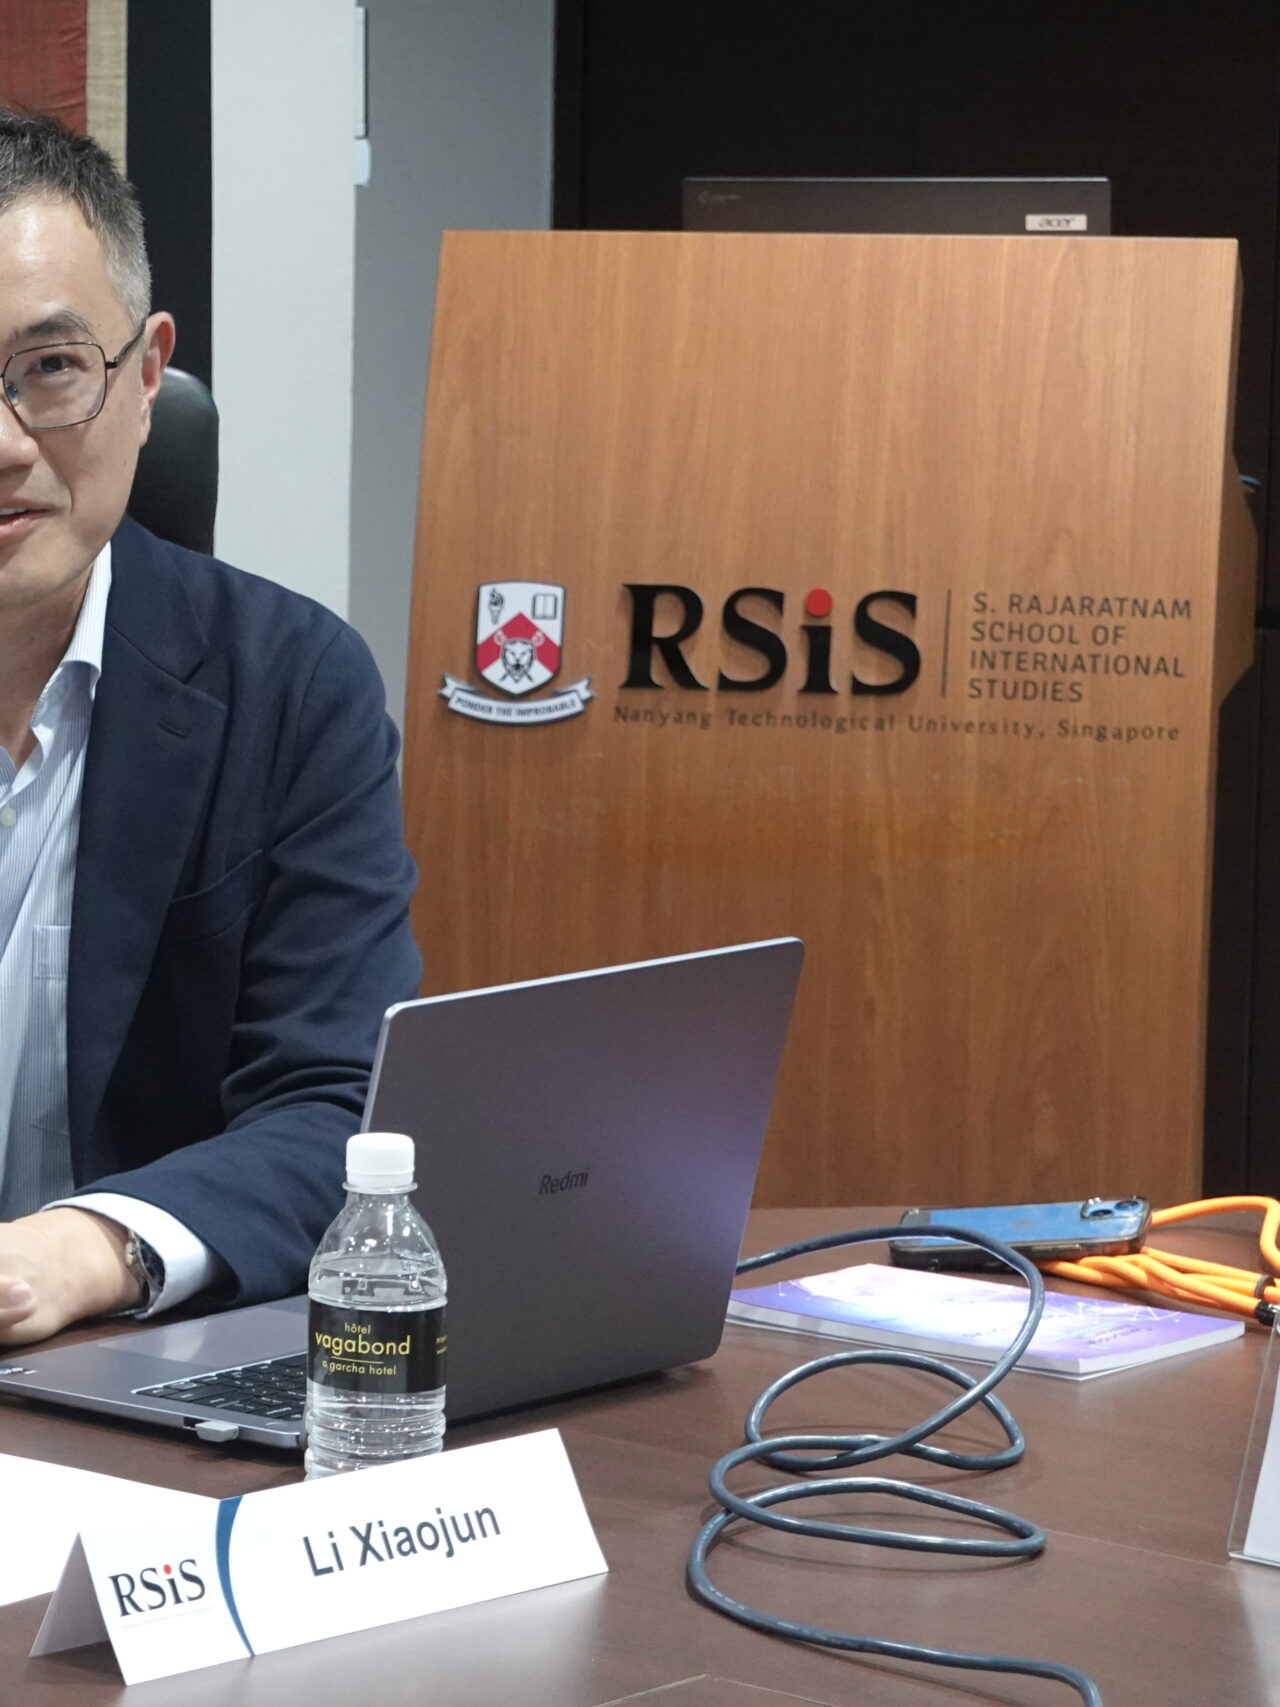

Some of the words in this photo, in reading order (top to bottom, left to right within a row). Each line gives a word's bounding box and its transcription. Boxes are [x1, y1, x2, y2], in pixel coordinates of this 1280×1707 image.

[973, 592, 998, 614] S.
[1007, 593, 1193, 620] RAJARATNAM
[619, 584, 921, 692] RSiS
[970, 621, 1080, 646] SCHOOL
[1090, 625, 1126, 647] OF
[969, 650, 1186, 678] INTERNATIONAL
[967, 679, 1084, 703] STUDIES
[613, 705, 712, 730] Nanyang
[727, 708, 896, 733] Technological
[907, 714, 1046, 740] University,
[1056, 719, 1180, 743] Singapore
[539, 1166, 590, 1195] Redmi
[344, 1322, 371, 1335] hôtel
[315, 1332, 411, 1356] vagabond
[322, 1360, 328, 1368] a
[329, 1362, 366, 1374] garcha
[369, 1364, 397, 1376] hotel
[303, 1531, 344, 1577] Li
[350, 1506, 501, 1567] Xiaojun
[108, 1558, 206, 1617] RSiS
